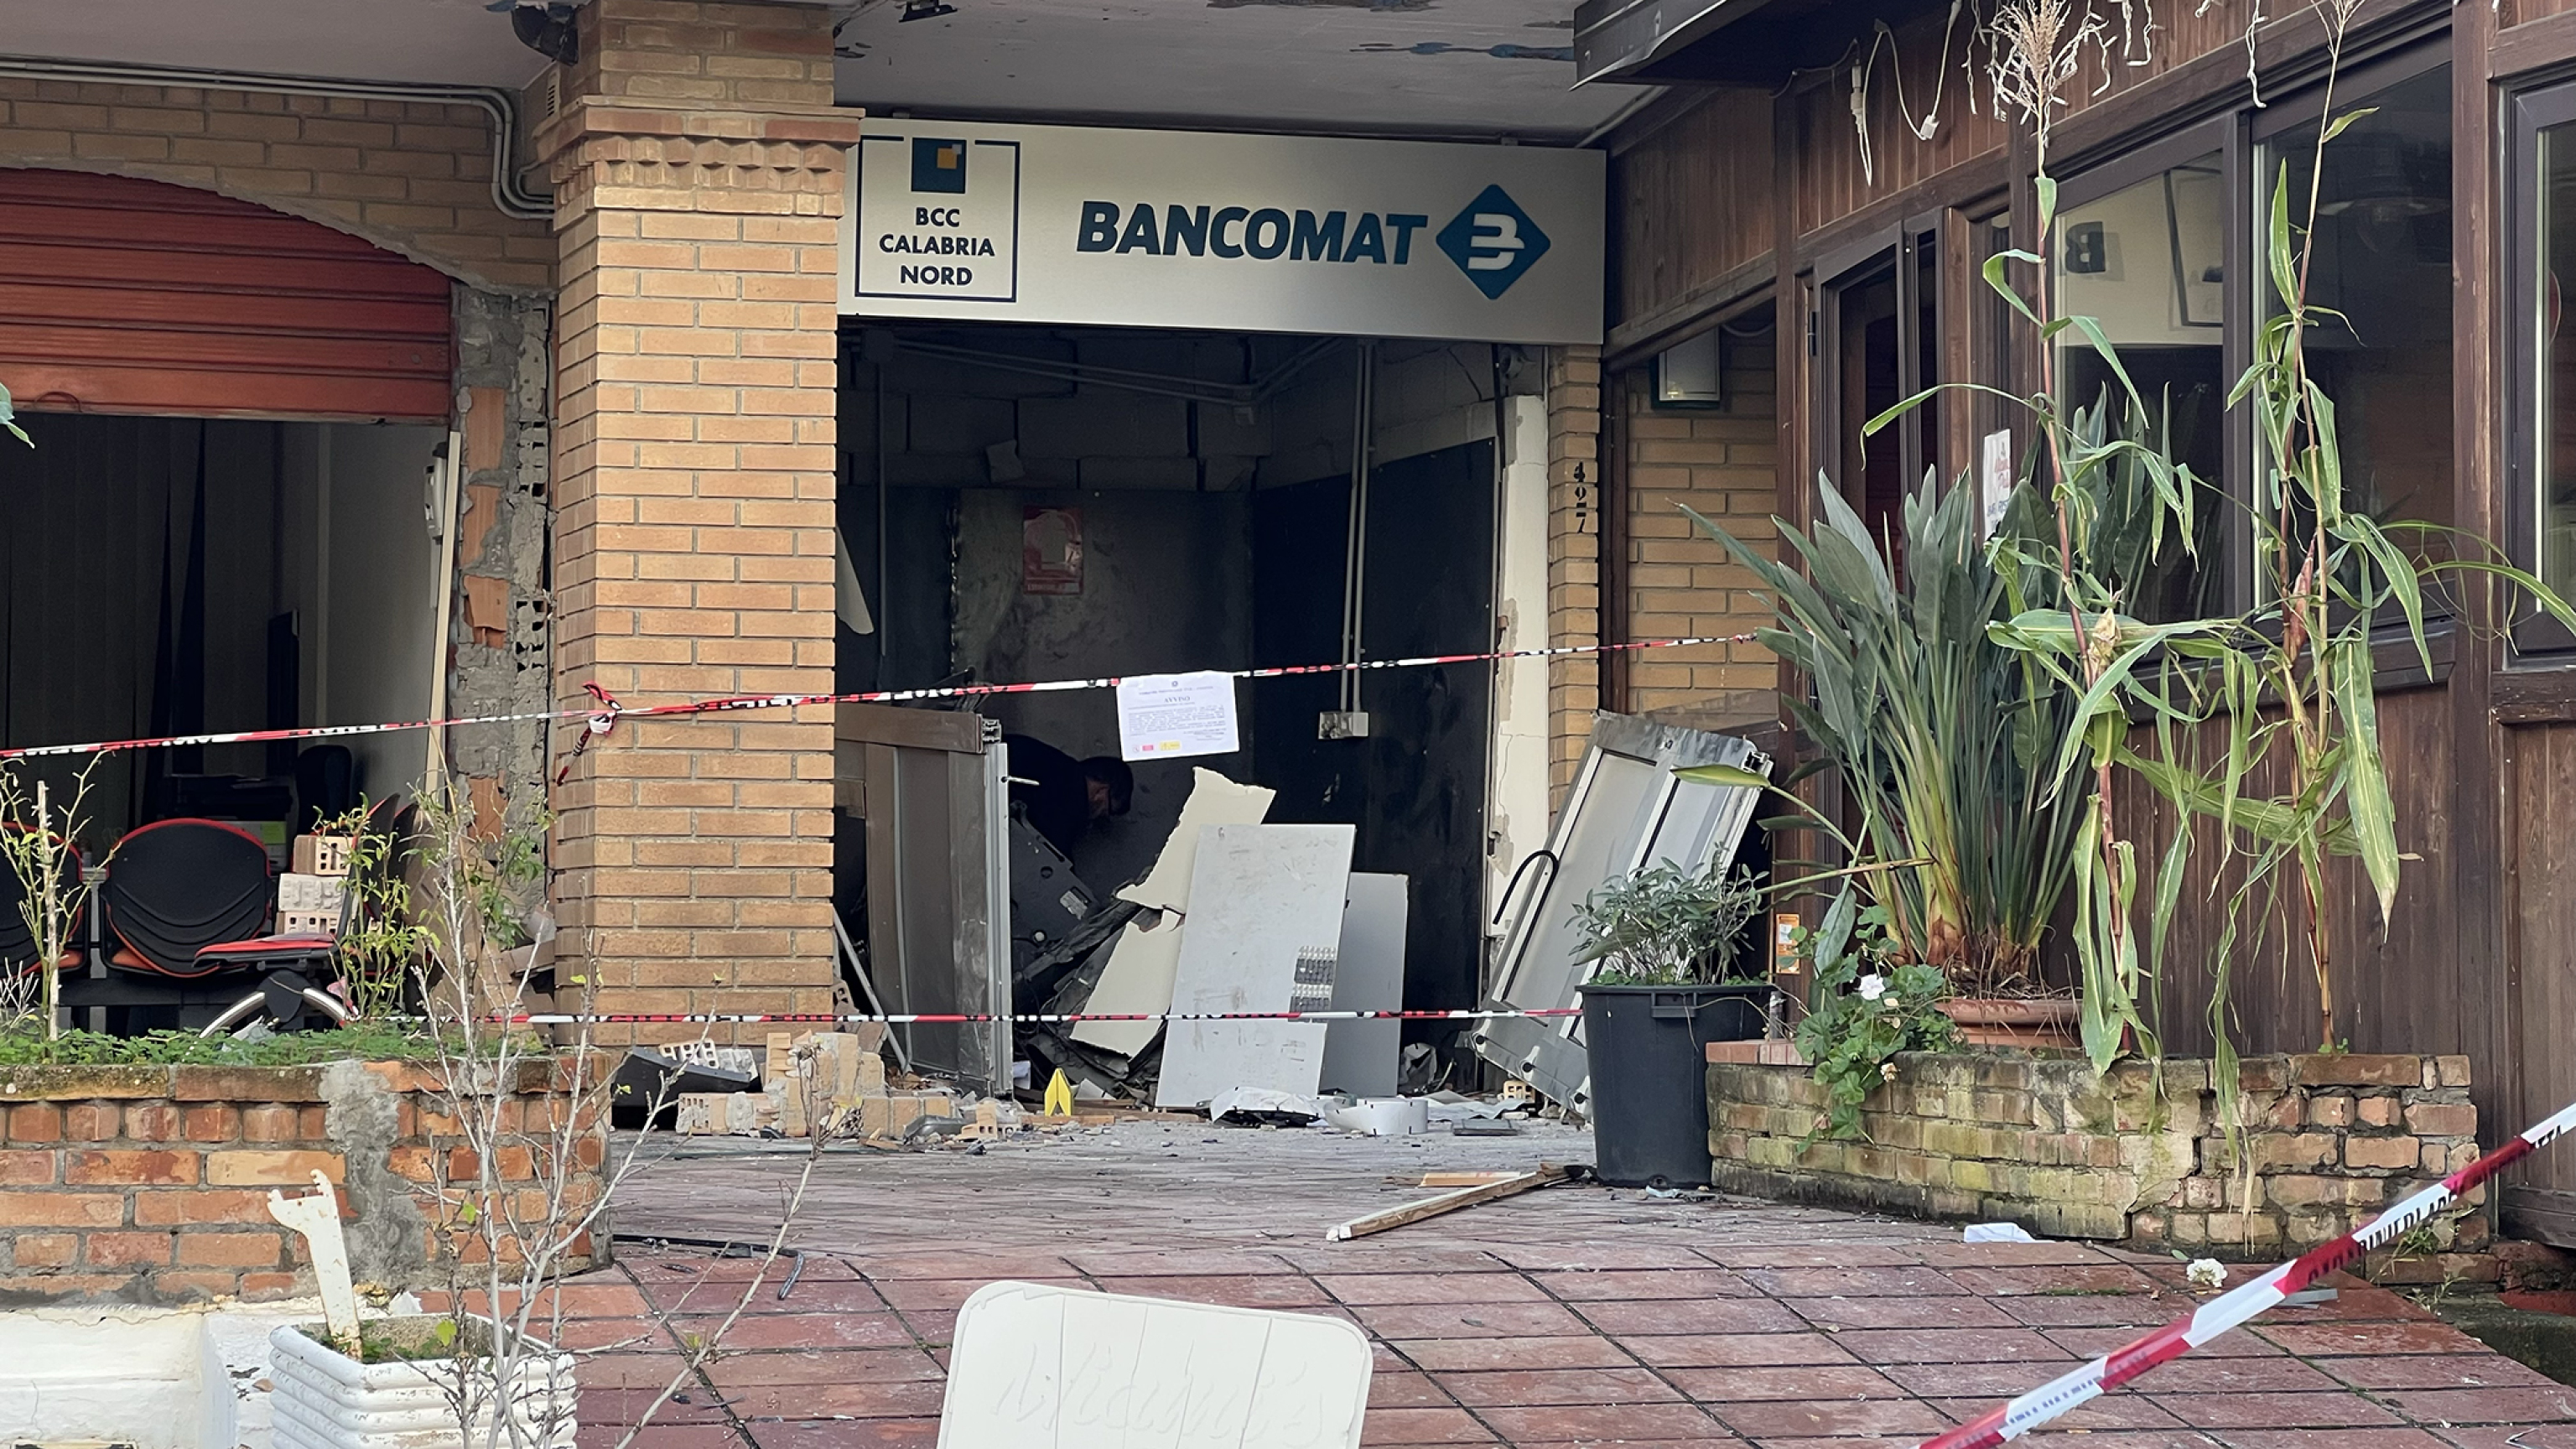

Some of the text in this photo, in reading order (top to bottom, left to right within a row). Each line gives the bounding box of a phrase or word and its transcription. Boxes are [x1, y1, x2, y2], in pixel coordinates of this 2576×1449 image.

[915, 206, 961, 227] BCC
[1076, 200, 1429, 266] BANCOMAT
[878, 233, 996, 257] CALABRIA
[899, 264, 974, 286] NORD
